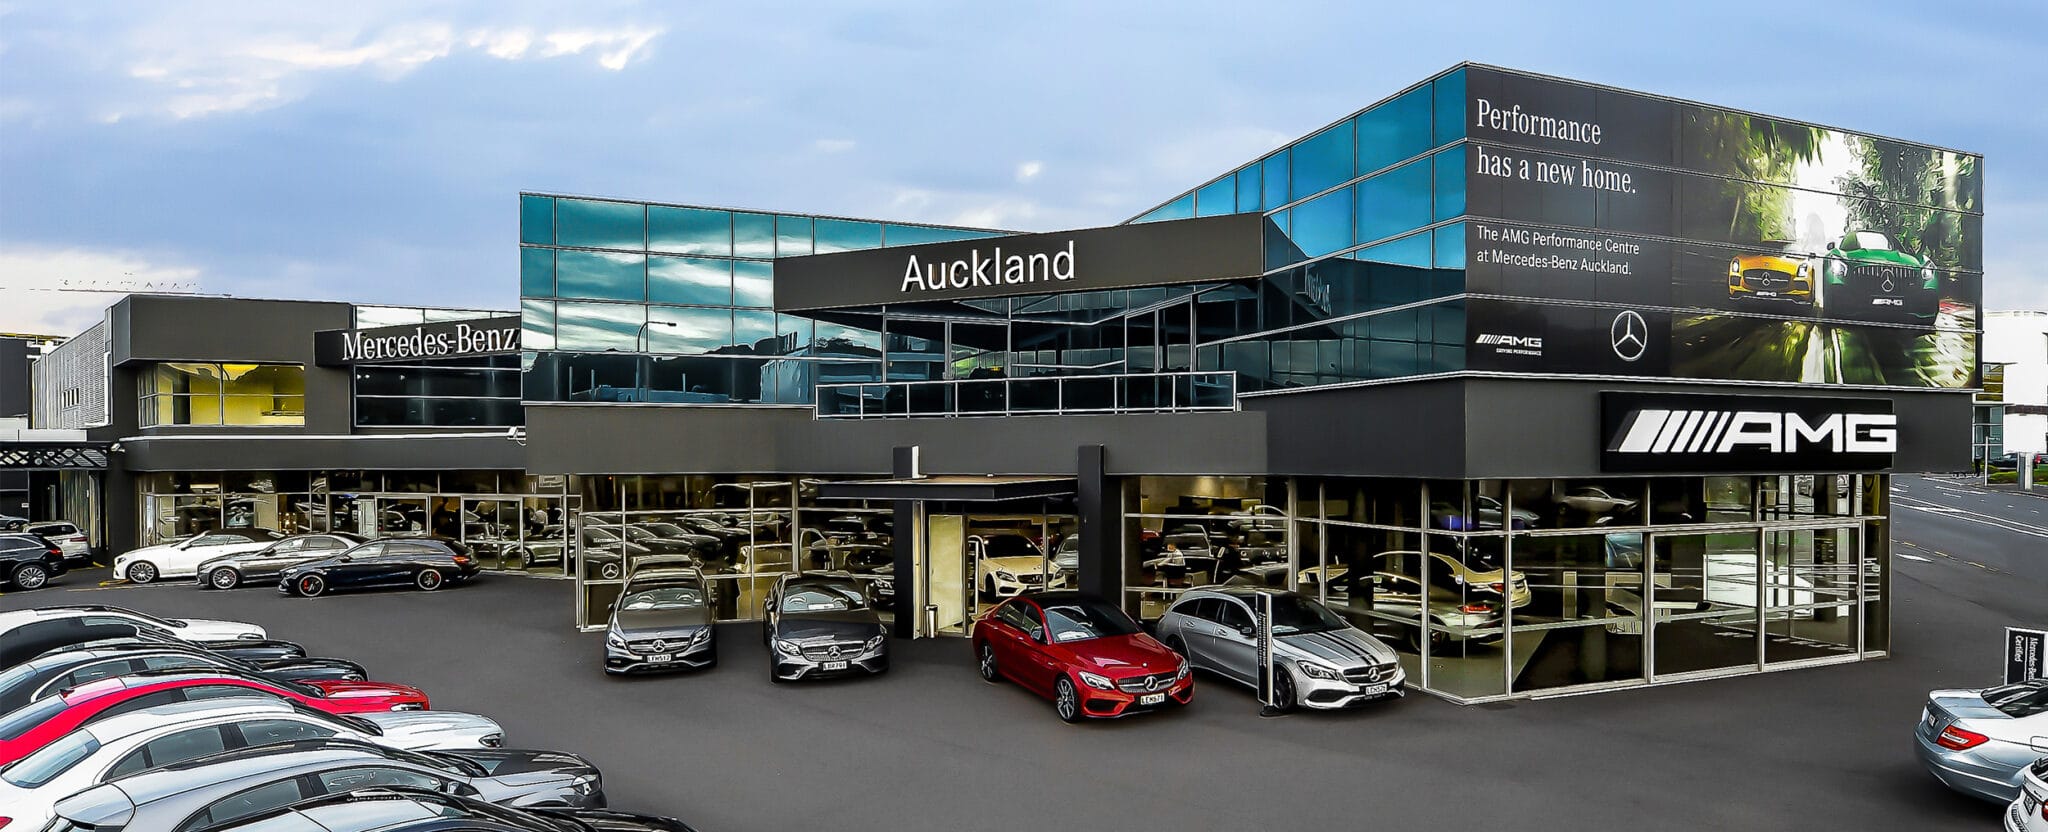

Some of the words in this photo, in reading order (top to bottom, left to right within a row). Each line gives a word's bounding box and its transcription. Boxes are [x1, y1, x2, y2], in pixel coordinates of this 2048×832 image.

[1477, 98, 1601, 145] Performance
[1477, 146, 1511, 178] has
[1519, 159, 1530, 180] a
[1537, 161, 1576, 186] new
[1582, 159, 1636, 194] home.
[1477, 225, 1498, 241] The
[1502, 228, 1530, 245] AMG
[1533, 232, 1601, 251] Performance
[1605, 239, 1640, 255] Centre
[901, 240, 1075, 292] Auckland
[1477, 250, 1489, 263] at
[1493, 250, 1577, 271] Mercedes-Benz
[1581, 258, 1632, 276] Auckland.
[342, 323, 516, 361] Mercedes-Benz
[1495, 335, 1542, 348] AMG
[1714, 411, 1897, 453] AMG
